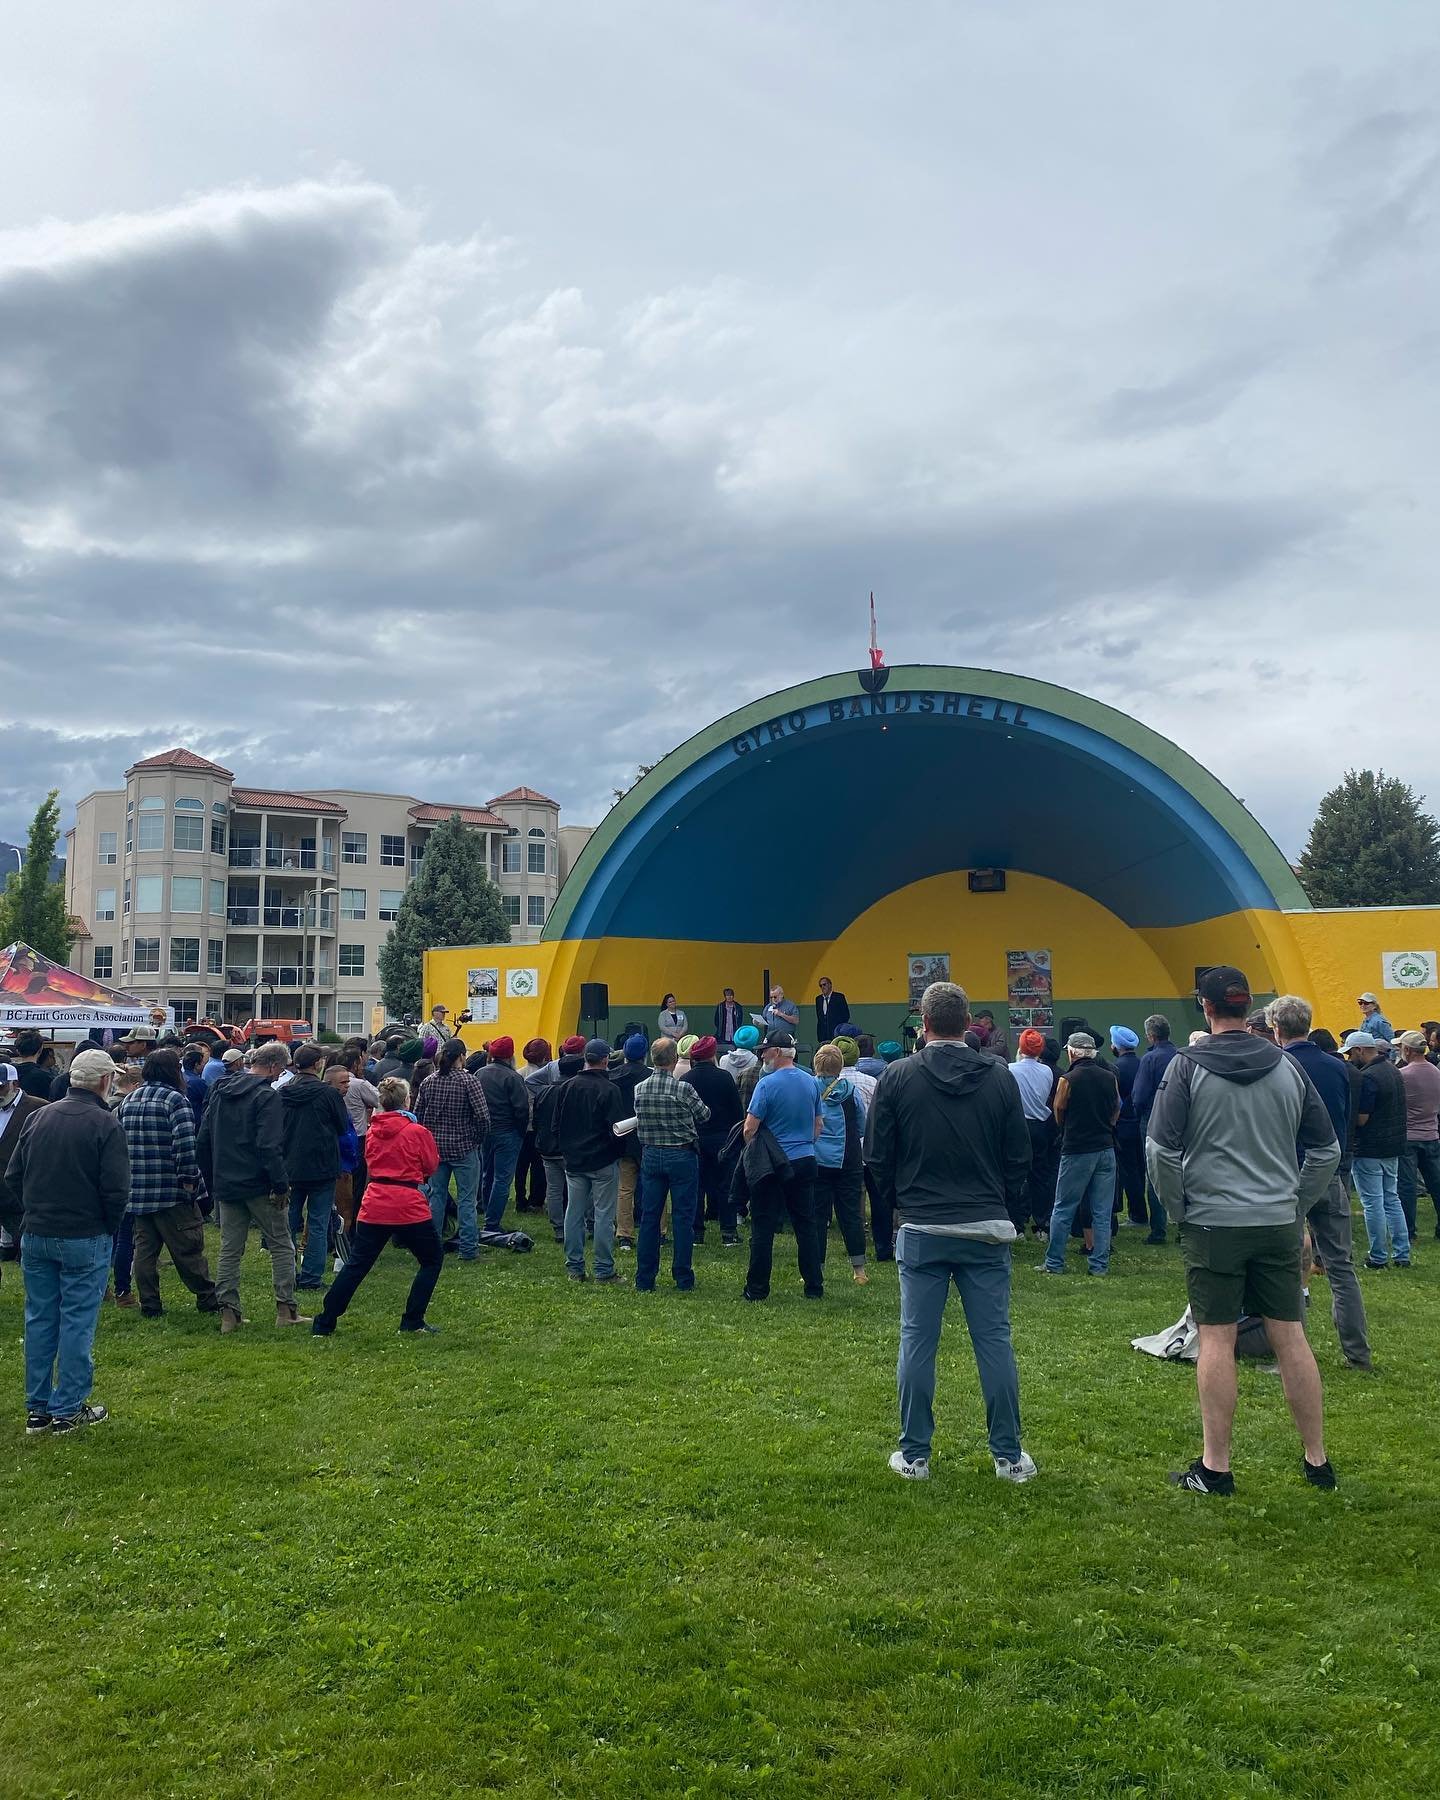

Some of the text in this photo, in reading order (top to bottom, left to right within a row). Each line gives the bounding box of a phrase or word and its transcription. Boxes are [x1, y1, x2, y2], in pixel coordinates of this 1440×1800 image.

[733, 692, 1029, 757] GYRO BANDSHELL
[6, 1010, 144, 1023] BC Fruit Growers Association
